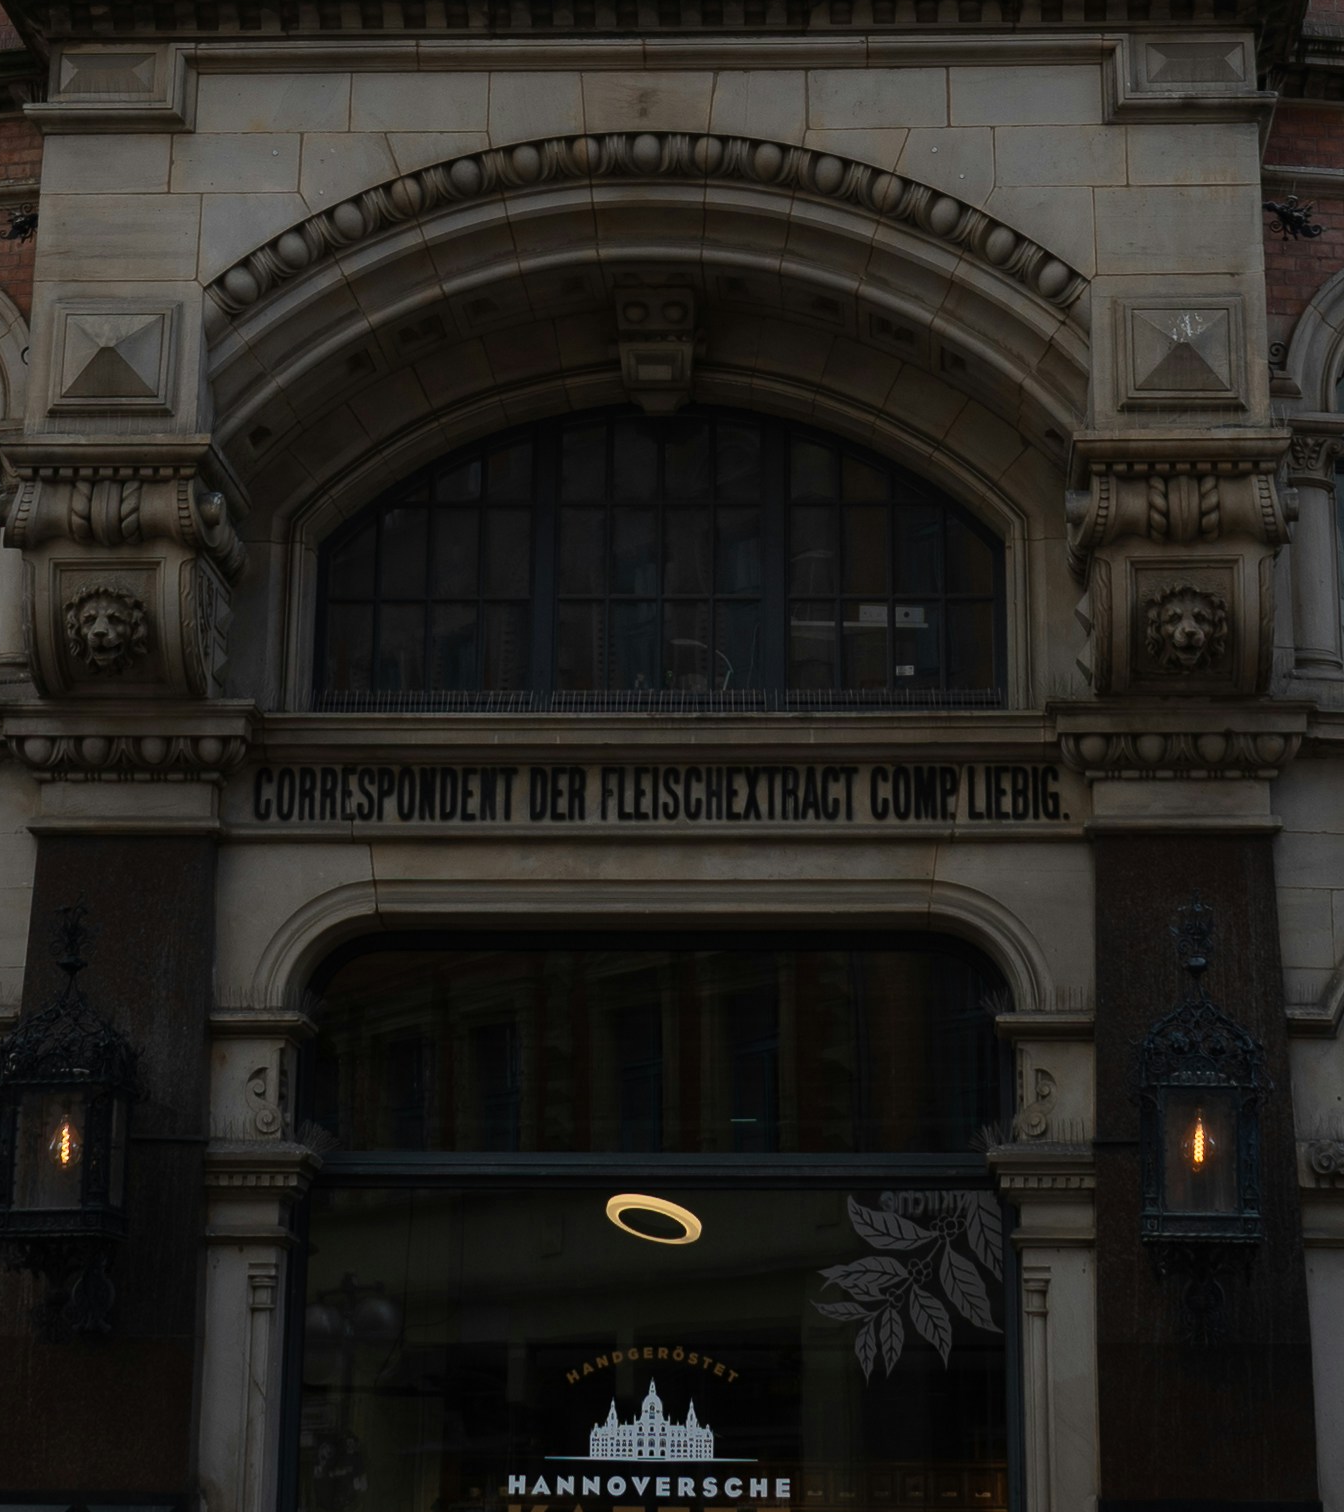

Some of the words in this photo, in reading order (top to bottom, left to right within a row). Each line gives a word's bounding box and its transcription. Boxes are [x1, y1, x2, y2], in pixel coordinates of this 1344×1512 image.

[254, 766, 518, 821] CORRESPONDENT
[530, 766, 586, 821] DER
[601, 766, 858, 821] FLEISCHEXTRACT
[967, 765, 1070, 821] LIEBIG.
[565, 1346, 739, 1384] HANDGERÖSTET
[507, 1474, 792, 1499] HANNOVERSCHE
